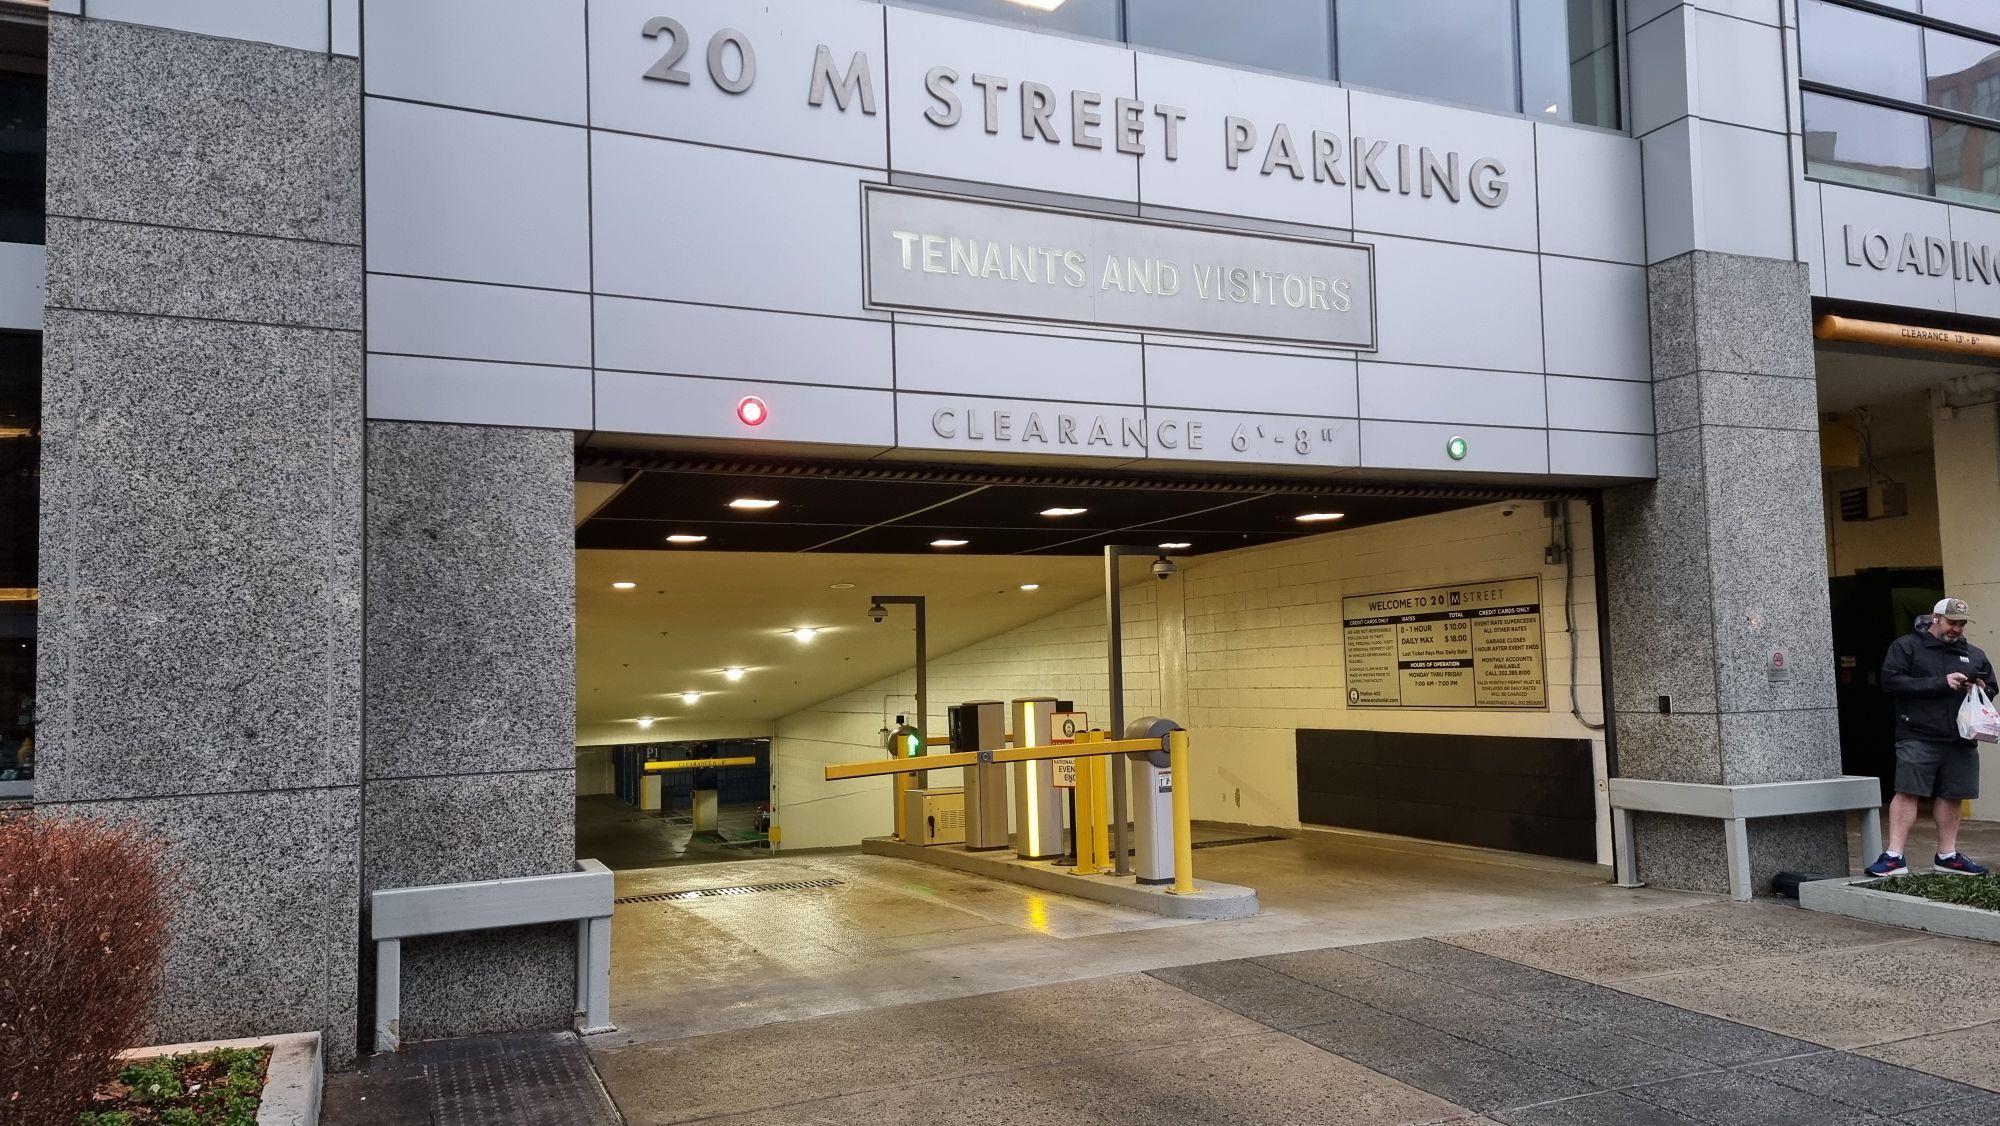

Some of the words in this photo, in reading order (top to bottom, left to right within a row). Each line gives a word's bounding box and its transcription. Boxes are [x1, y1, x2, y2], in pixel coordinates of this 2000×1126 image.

[641, 16, 756, 94] 20
[807, 44, 877, 115] M
[924, 65, 1186, 161] STREET
[1225, 115, 1509, 208] PARKING
[1843, 224, 2000, 285] LOADIN
[893, 229, 1088, 289] TENANTS
[1101, 255, 1180, 297] AND
[1193, 262, 1353, 313] VISITORS
[1901, 328, 1949, 342] CLEARANCE
[932, 407, 1204, 451] CLEARANCE
[1368, 597, 1412, 611] WELCOME
[1415, 597, 1427, 607] TO
[1431, 595, 1445, 606] 20
[1450, 592, 1460, 605] M
[1464, 589, 1503, 603] STREET
[1414, 624, 1432, 633] HOUR
[1401, 637, 1419, 645] DAILY
[1420, 636, 1434, 644] MAX
[646, 747, 658, 758] P1
